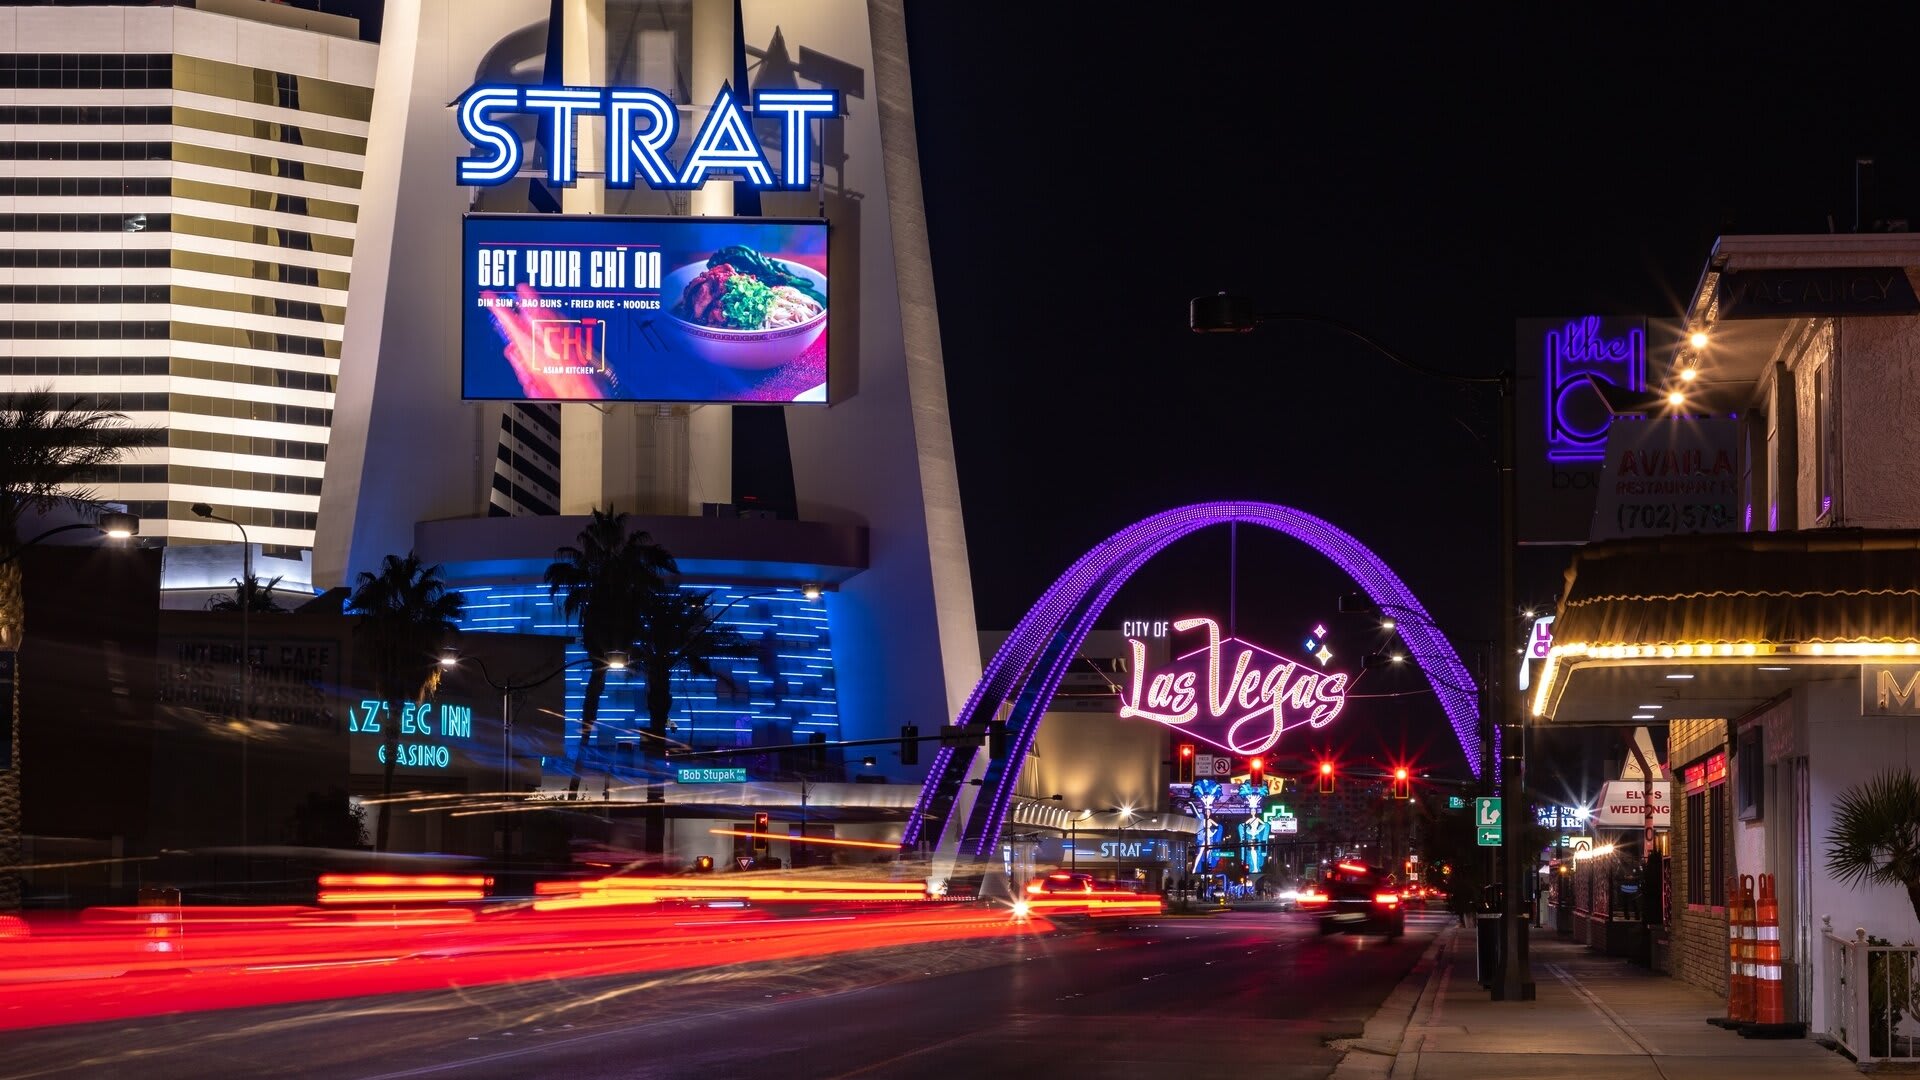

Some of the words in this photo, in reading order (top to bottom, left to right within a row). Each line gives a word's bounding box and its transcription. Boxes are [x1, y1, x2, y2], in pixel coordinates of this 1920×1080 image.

[457, 81, 838, 191] STRAT
[478, 250, 517, 286] GET
[526, 251, 581, 287] YOUR
[634, 252, 661, 289] ON
[1725, 275, 1895, 306] VACANCY
[478, 299, 493, 307] DIM
[496, 299, 513, 308] SUM
[522, 300, 538, 308] BAO
[540, 300, 562, 308] BUNS
[571, 300, 594, 309] FRIED
[596, 300, 615, 309] RICE
[623, 301, 661, 310] NOODLES
[1562, 313, 1630, 362] the
[543, 367, 564, 375] ASIAN
[565, 367, 594, 375] KITCHEN
[1617, 449, 1738, 477] AVAILA
[1123, 621, 1149, 637] CITY
[1154, 622, 1169, 637] OF
[280, 647, 328, 665] CAFE
[1120, 638, 1198, 724] Las
[1173, 618, 1348, 755] Vegas
[441, 704, 471, 738] INN
[684, 770, 700, 779] Bob
[704, 769, 735, 781] Stupak
[1626, 791, 1662, 799] ELVS
[1610, 805, 1670, 814] WEDDNG
[1101, 842, 1142, 857] STRAT
